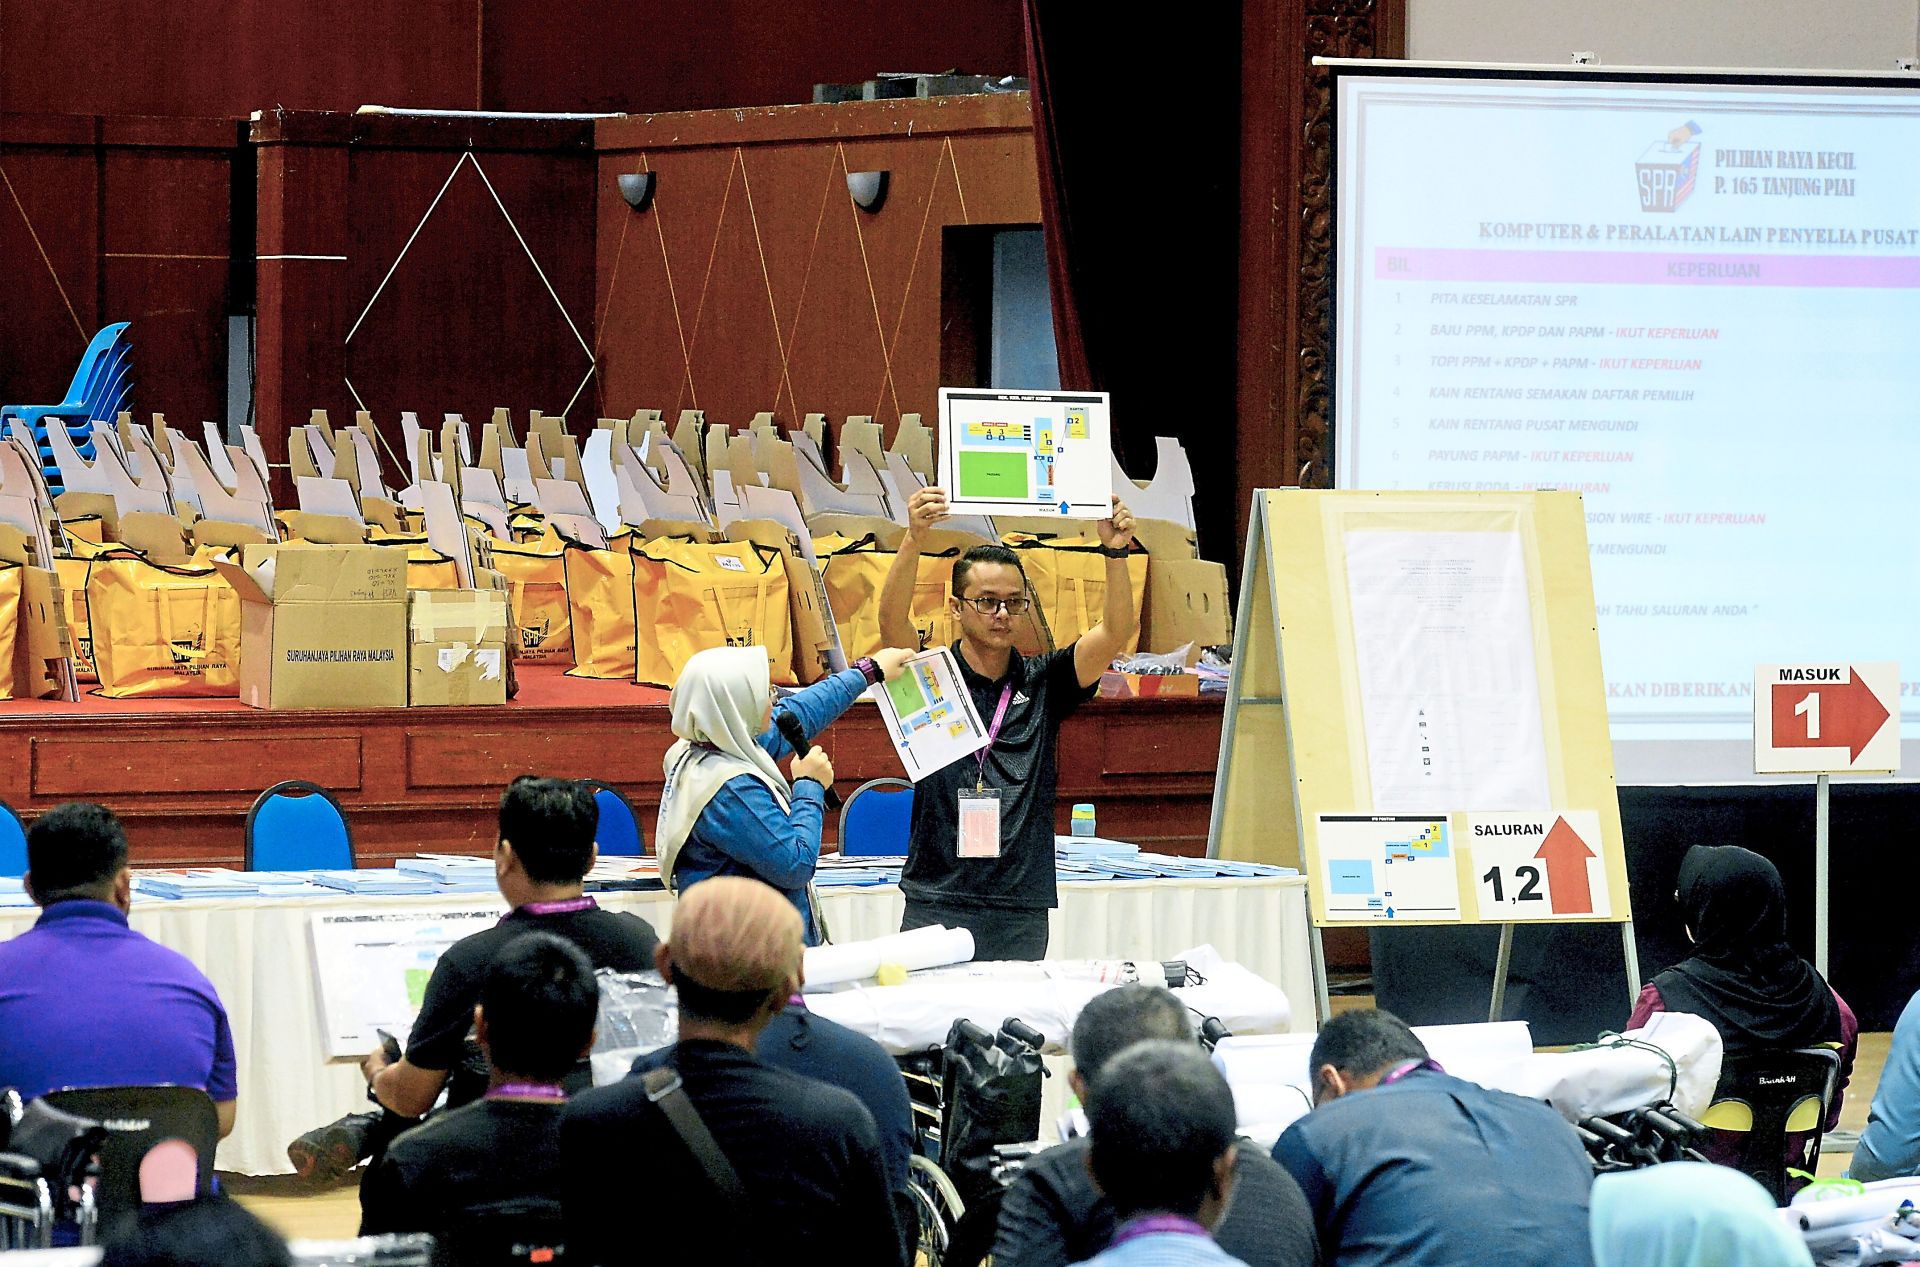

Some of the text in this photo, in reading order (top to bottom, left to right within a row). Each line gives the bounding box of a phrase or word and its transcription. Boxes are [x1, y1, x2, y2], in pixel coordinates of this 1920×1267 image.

[1714, 149, 1856, 170] PILIHAN RAYA KECIL
[1639, 169, 1676, 208] SPR
[1714, 176, 1855, 198] P. 165 TANJUNG PIAI
[1479, 222, 1918, 245] KOMPUTER & PERALATAN LAIN PENYELIA PUSAT
[1666, 262, 1760, 278] KEPERLUAN
[1430, 292, 1458, 304] PITA
[1461, 293, 1551, 306] KESELAMATAN
[1554, 294, 1578, 306] SPR
[1430, 324, 1462, 336] BAJU
[1501, 326, 1536, 338] KPDP
[1538, 327, 1566, 338] DAN
[1568, 327, 1604, 339] PAPM
[1616, 328, 1644, 340] IKUT
[1647, 328, 1720, 341] KEPERLUAN
[1430, 355, 1459, 368] TOPI
[1461, 356, 1492, 368] PPM
[1504, 357, 1538, 369] KPDP
[1552, 358, 1588, 370] PAPM
[1599, 358, 1628, 370] IKUT
[1630, 358, 1702, 371] KEPERLUAN
[1428, 387, 1460, 400] KAIN
[1462, 388, 1522, 400] RENTANG
[1526, 388, 1588, 401] SEMAKAN
[1592, 389, 1640, 401] DAFTAR
[1642, 390, 1695, 402] PEMILIH
[1428, 418, 1460, 430] KAIN
[1462, 419, 1522, 431] RENTANG
[1526, 420, 1565, 432] PUSAT
[1568, 420, 1640, 432] MENGUNDI
[1428, 450, 1478, 462] PAYUNG
[1482, 450, 1520, 462] PAPM
[1530, 451, 1560, 463] IKUT
[1562, 451, 1634, 463] KEPERLUAN
[1620, 512, 1654, 524] WIRE
[1664, 512, 1692, 524] IKUT
[1694, 512, 1766, 524] KEPERLUAN
[1596, 544, 1668, 555] MENGUNDI
[1615, 604, 1648, 616] TAHU
[1650, 605, 1708, 616] SALURAN
[523, 630, 539, 646] SPR
[286, 648, 394, 662] SURUHANJAYA PILIHAN RAYA MALAYSIA
[1779, 668, 1841, 682] MASUK
[1651, 682, 1751, 698] DIBERIKAN
[1012, 696, 1030, 705] adidas
[1794, 691, 1820, 740] 1
[1474, 824, 1544, 836] SALURAN
[1482, 865, 1544, 904] 1,2
